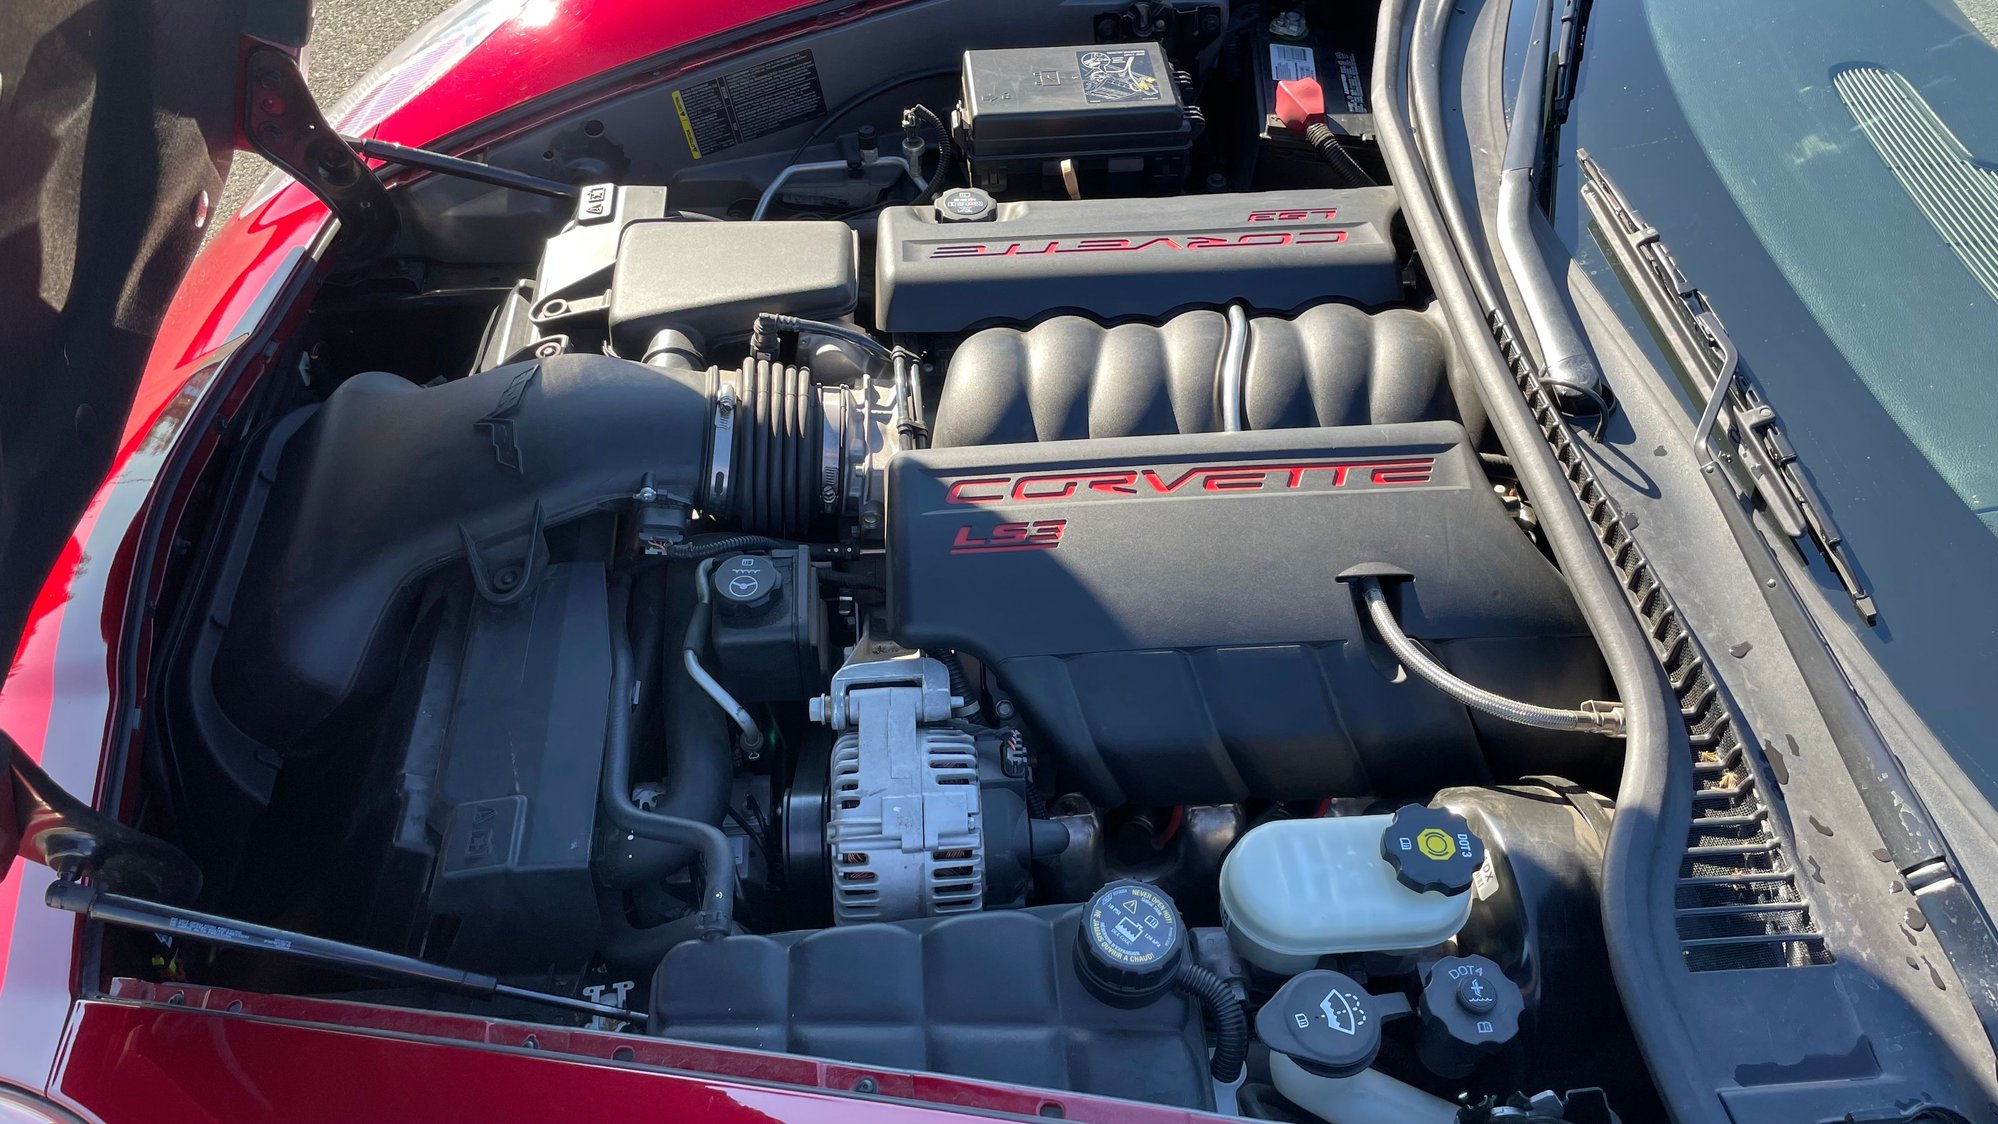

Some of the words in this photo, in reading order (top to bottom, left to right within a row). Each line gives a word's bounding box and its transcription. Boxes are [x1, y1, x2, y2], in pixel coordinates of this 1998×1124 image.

[1247, 208, 1338, 222] LS3
[929, 230, 1348, 259] CORVETTE
[945, 457, 1436, 505] CORVETTE
[950, 518, 1069, 554] LS3
[1132, 889, 1151, 900] NEVER
[1152, 897, 1166, 911] OPEN
[1101, 941, 1123, 960] OUVRIR
[1130, 952, 1156, 962] CHAUD!
[1448, 965, 1483, 980] DOT4
